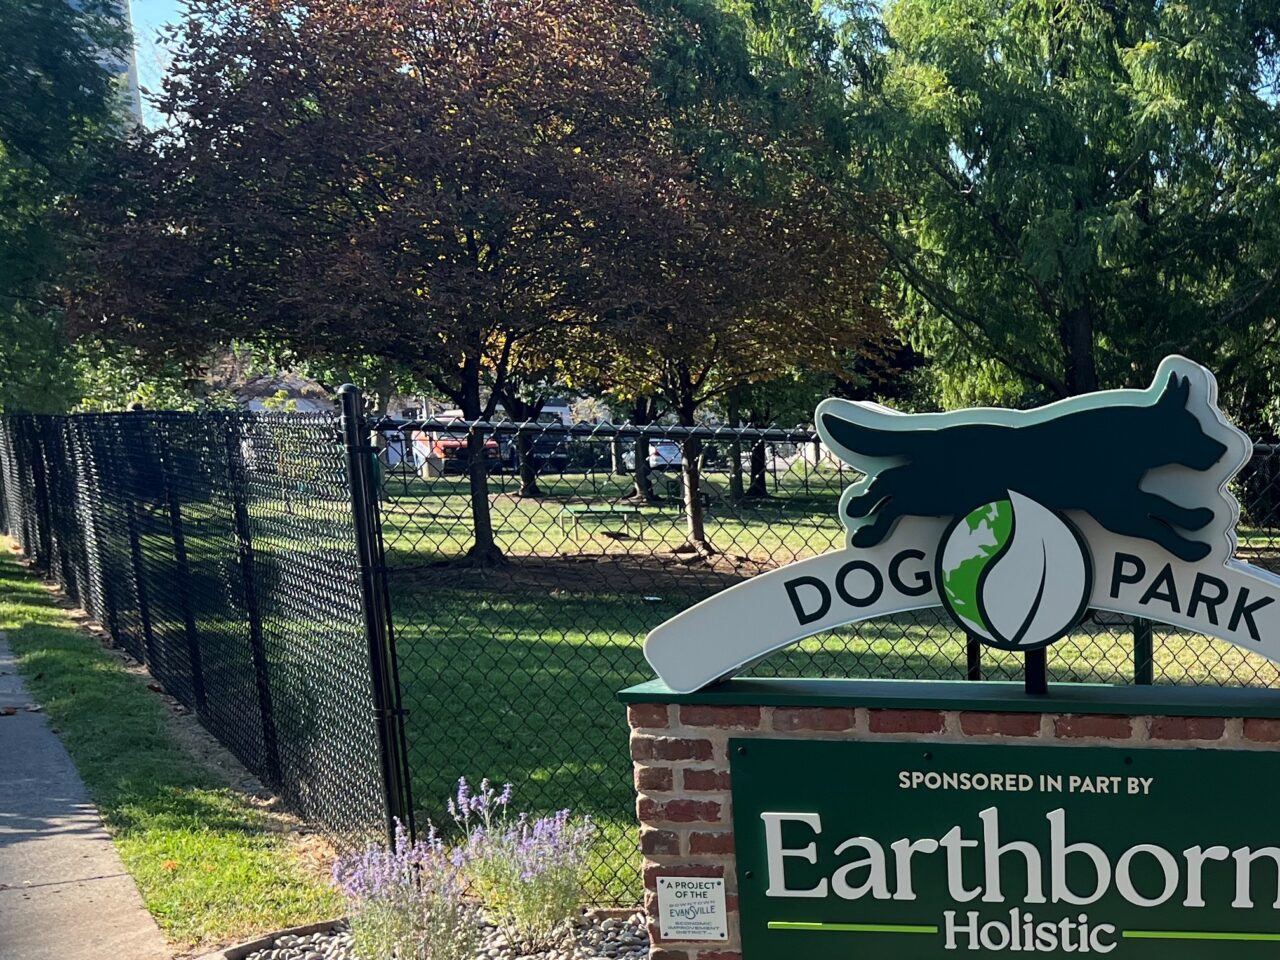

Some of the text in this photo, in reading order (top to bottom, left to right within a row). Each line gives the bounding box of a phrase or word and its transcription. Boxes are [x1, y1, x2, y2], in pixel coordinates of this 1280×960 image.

[785, 548, 1276, 643] DOG PARK
[898, 771, 1154, 795] SPONSORED IN PART BY
[675, 882, 715, 890] PROJECT
[675, 891, 688, 899] OF
[669, 905, 716, 920] EVANSVILLE
[943, 907, 1118, 954] Holistic
